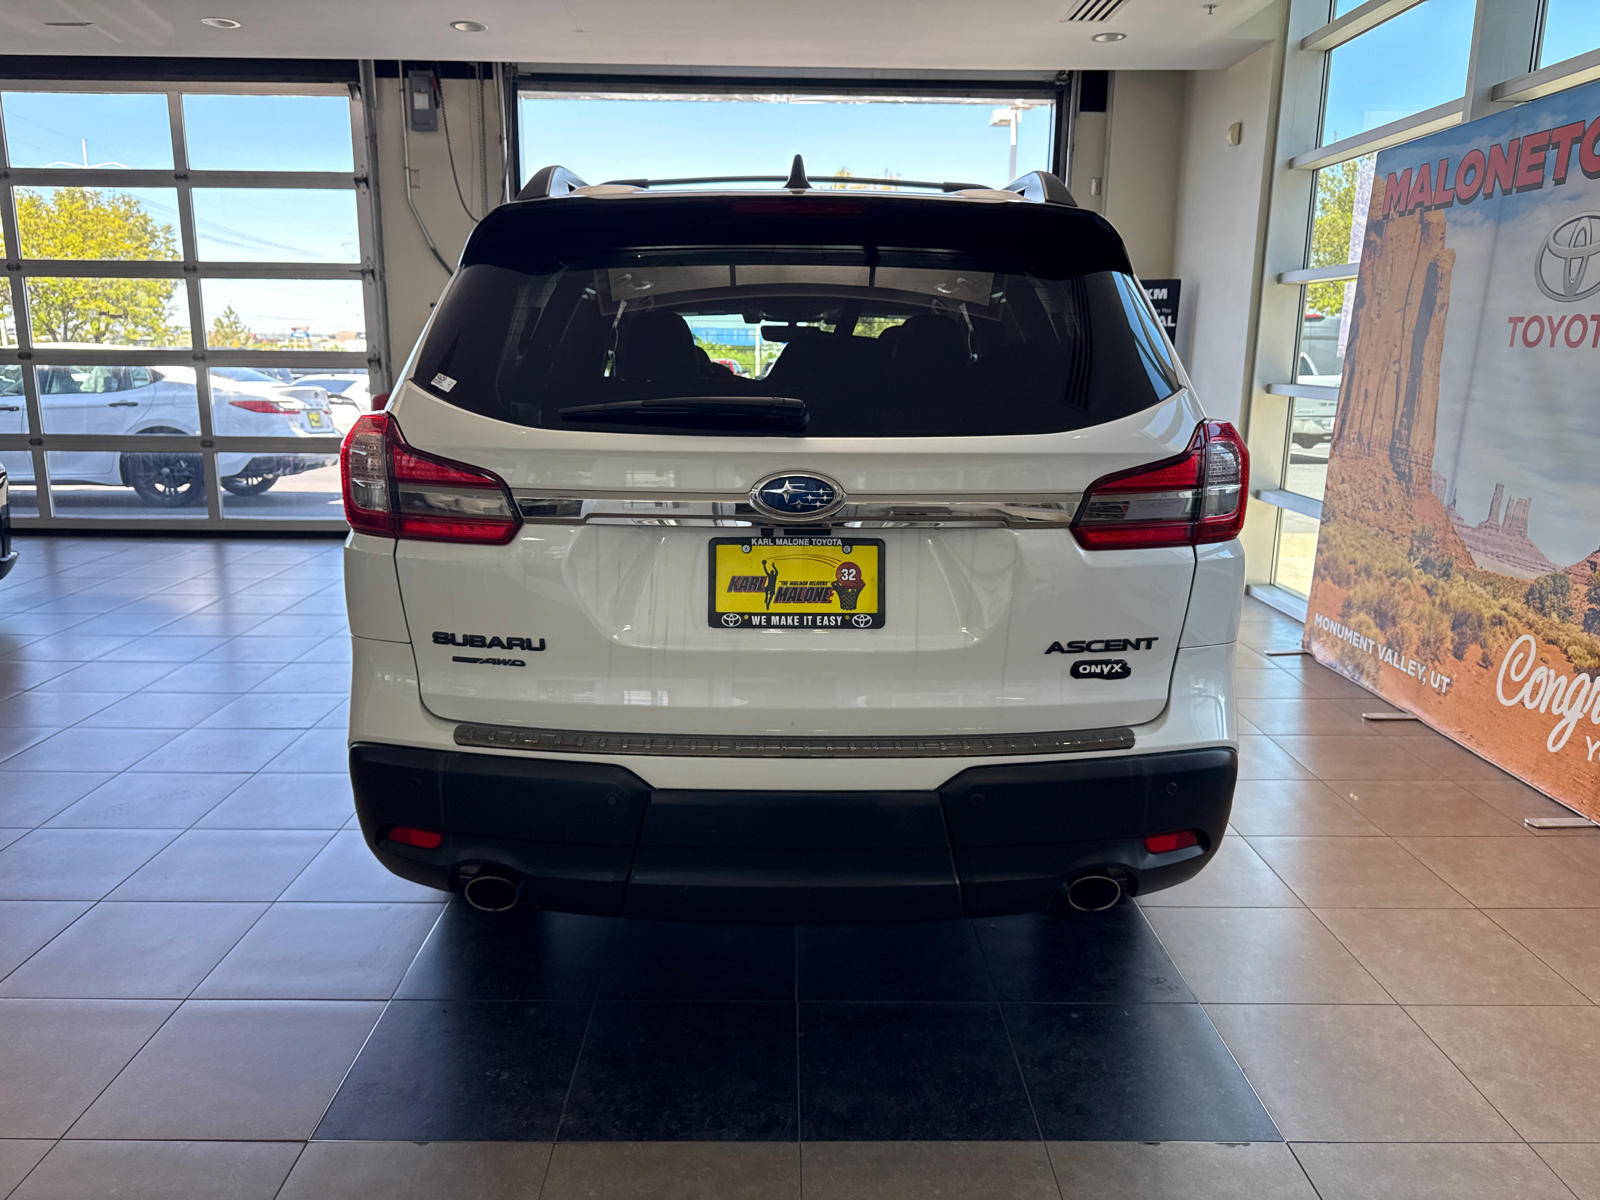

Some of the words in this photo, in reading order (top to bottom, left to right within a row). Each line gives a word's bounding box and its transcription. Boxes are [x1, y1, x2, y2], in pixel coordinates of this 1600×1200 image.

[751, 538, 774, 546] KARL
[775, 538, 810, 546] MALONE
[811, 538, 843, 546] TOYOTA
[841, 568, 856, 581] 32
[727, 576, 767, 593] KARL
[773, 586, 833, 603] MALONE
[751, 615, 767, 626] WE
[771, 615, 800, 626] MAKE
[803, 615, 813, 626] IT
[816, 615, 842, 626] EASY
[432, 631, 546, 651] SUBARU
[1044, 637, 1159, 654] ASCENT
[1314, 613, 1375, 654] MONUMENT
[1377, 643, 1427, 685] VALLEY,
[1430, 670, 1451, 693] UT
[479, 658, 526, 667] AWD
[1079, 663, 1123, 675] ONYX
